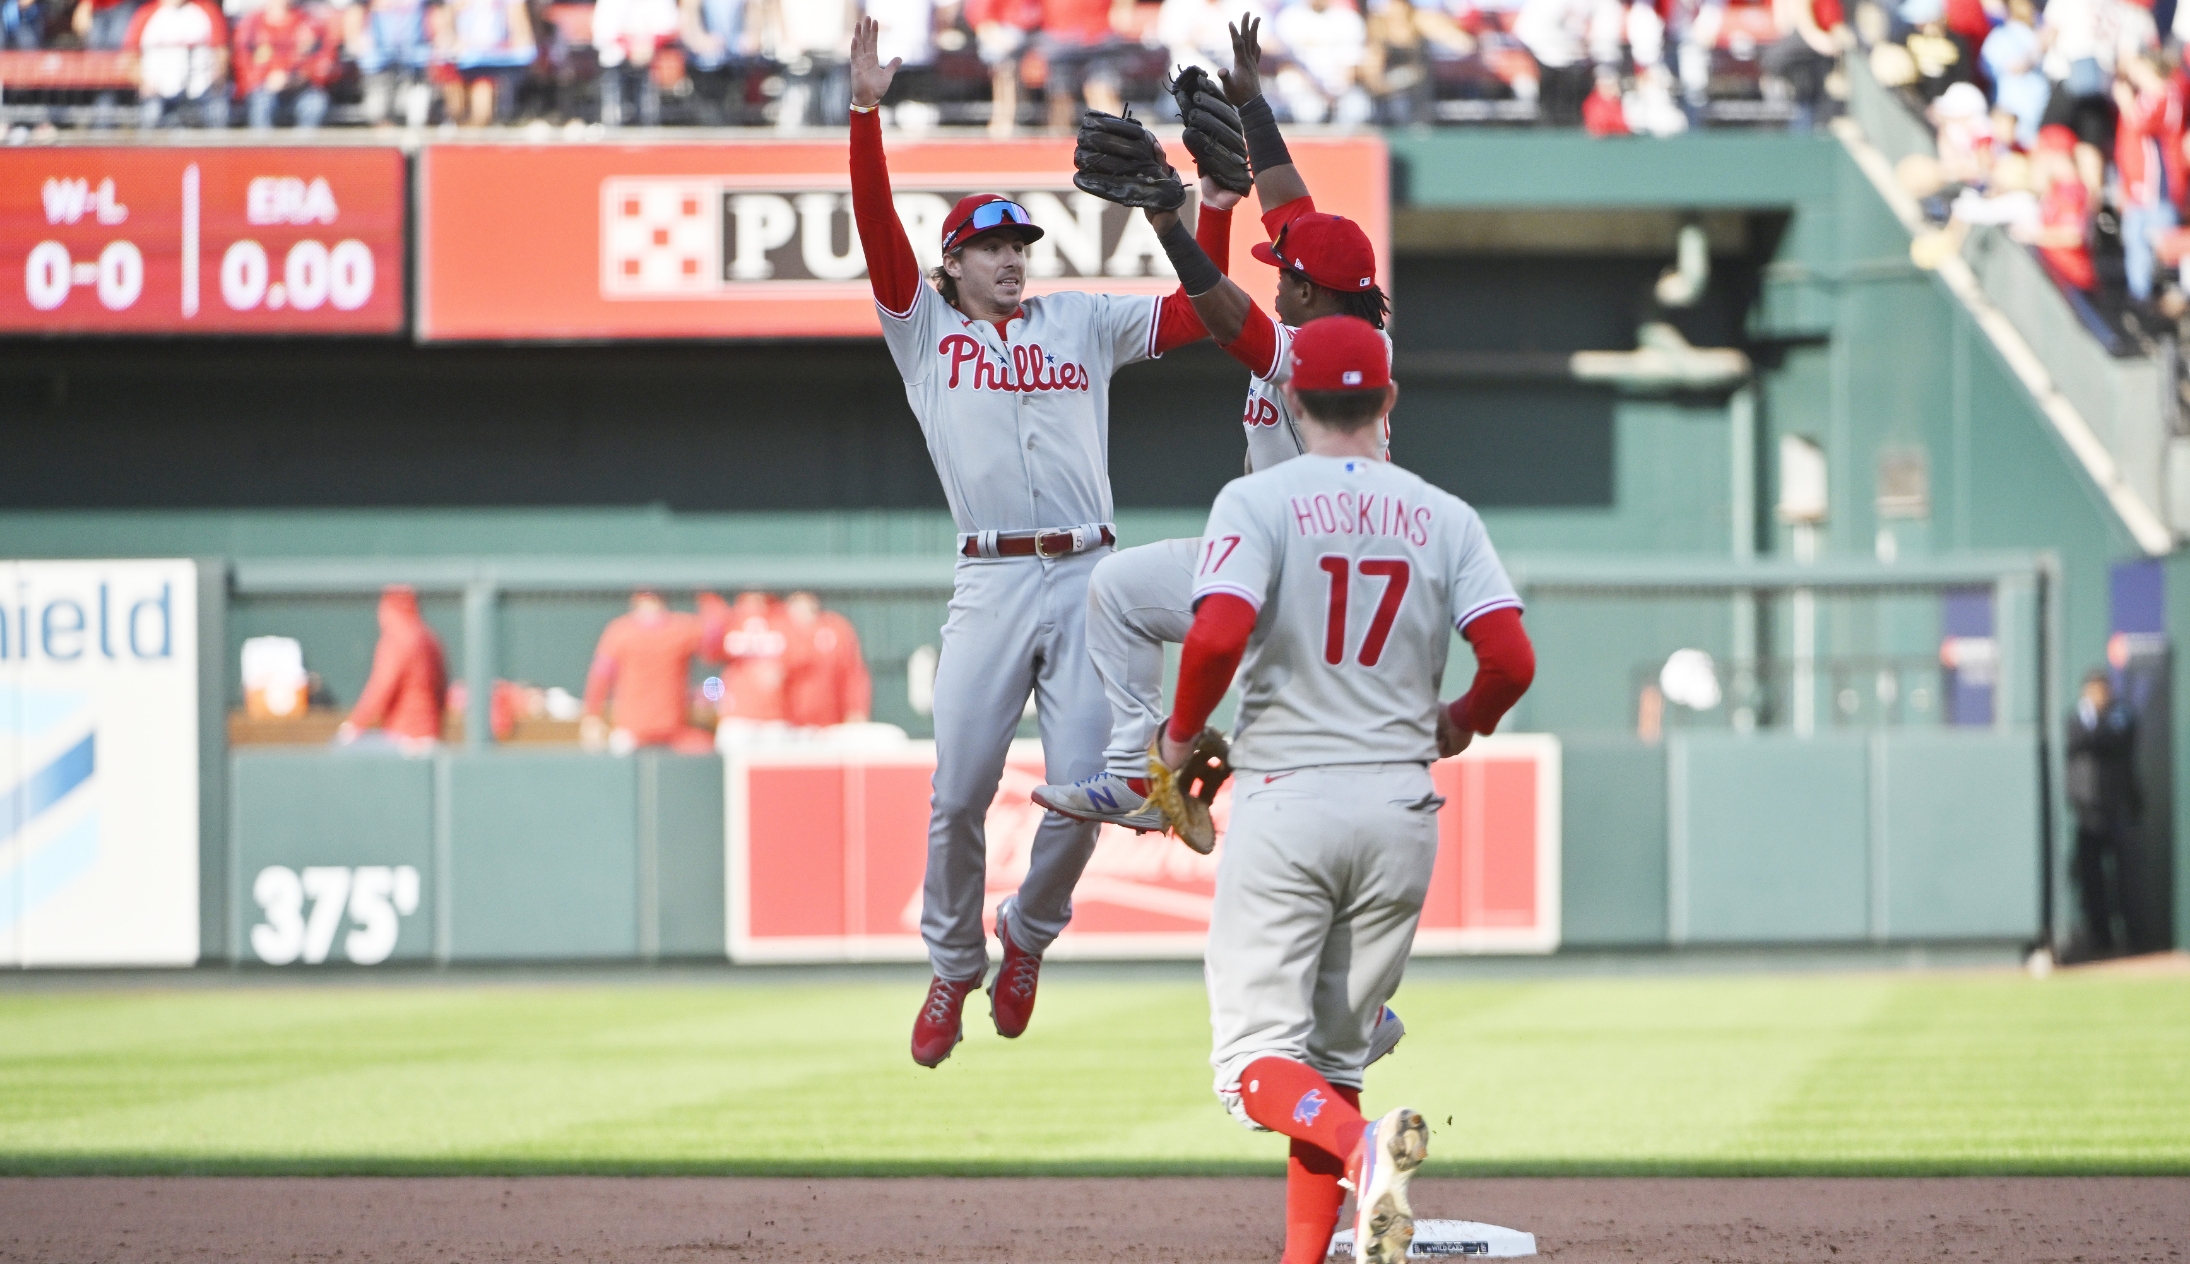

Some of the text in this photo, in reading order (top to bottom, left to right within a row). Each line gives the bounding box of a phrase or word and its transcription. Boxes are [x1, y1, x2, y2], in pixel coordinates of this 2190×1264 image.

[43, 176, 129, 225] W-L
[246, 176, 339, 225] ERA
[727, 192, 1181, 278] PURNA
[25, 239, 144, 311] 0-0
[220, 238, 375, 311] 0.00
[937, 332, 1090, 394] Phillies
[1076, 535, 1083, 549] 5
[1289, 491, 1432, 548] HOSKINS
[1199, 535, 1242, 577] 17
[1317, 553, 1411, 669] 17
